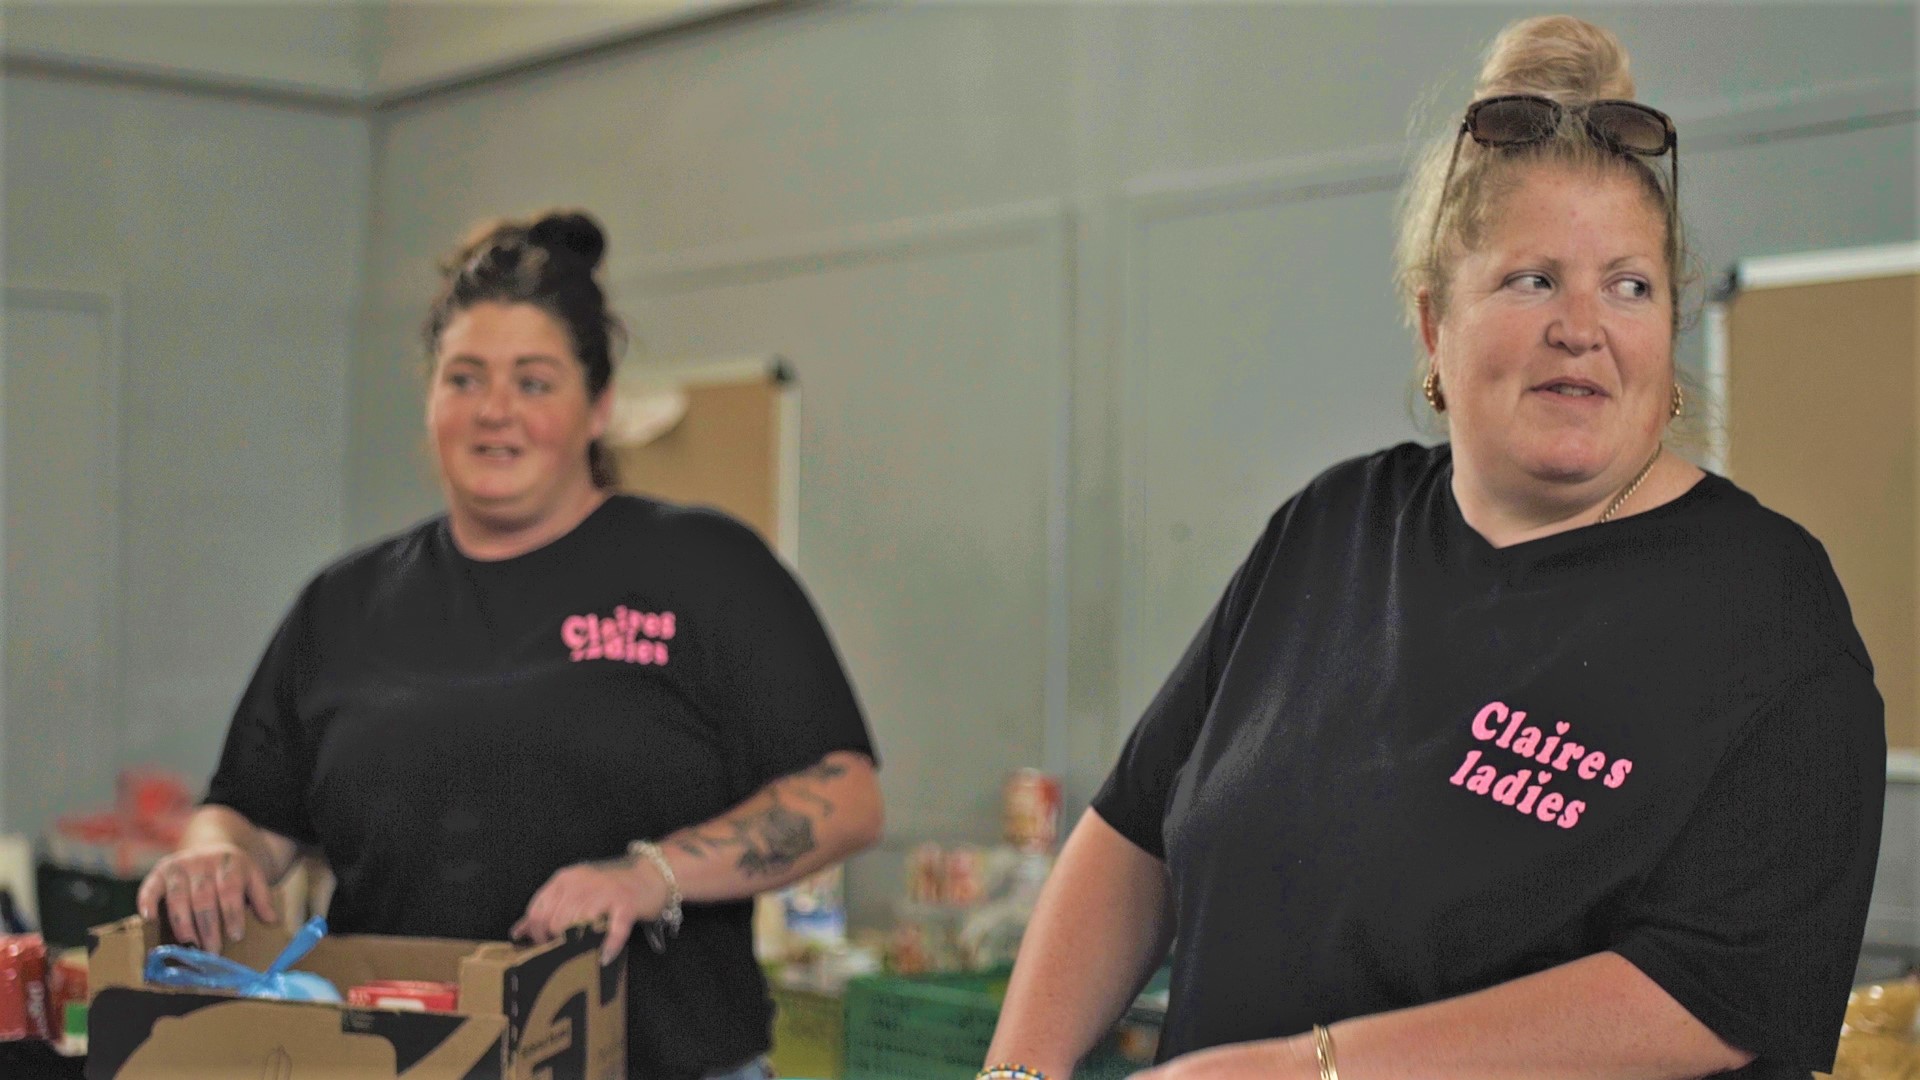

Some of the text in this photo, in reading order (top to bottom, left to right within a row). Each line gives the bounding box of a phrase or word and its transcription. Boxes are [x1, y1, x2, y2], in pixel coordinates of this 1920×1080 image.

[561, 605, 676, 649] Claires
[1471, 701, 1633, 789] Claires
[1449, 750, 1586, 829] ladies
